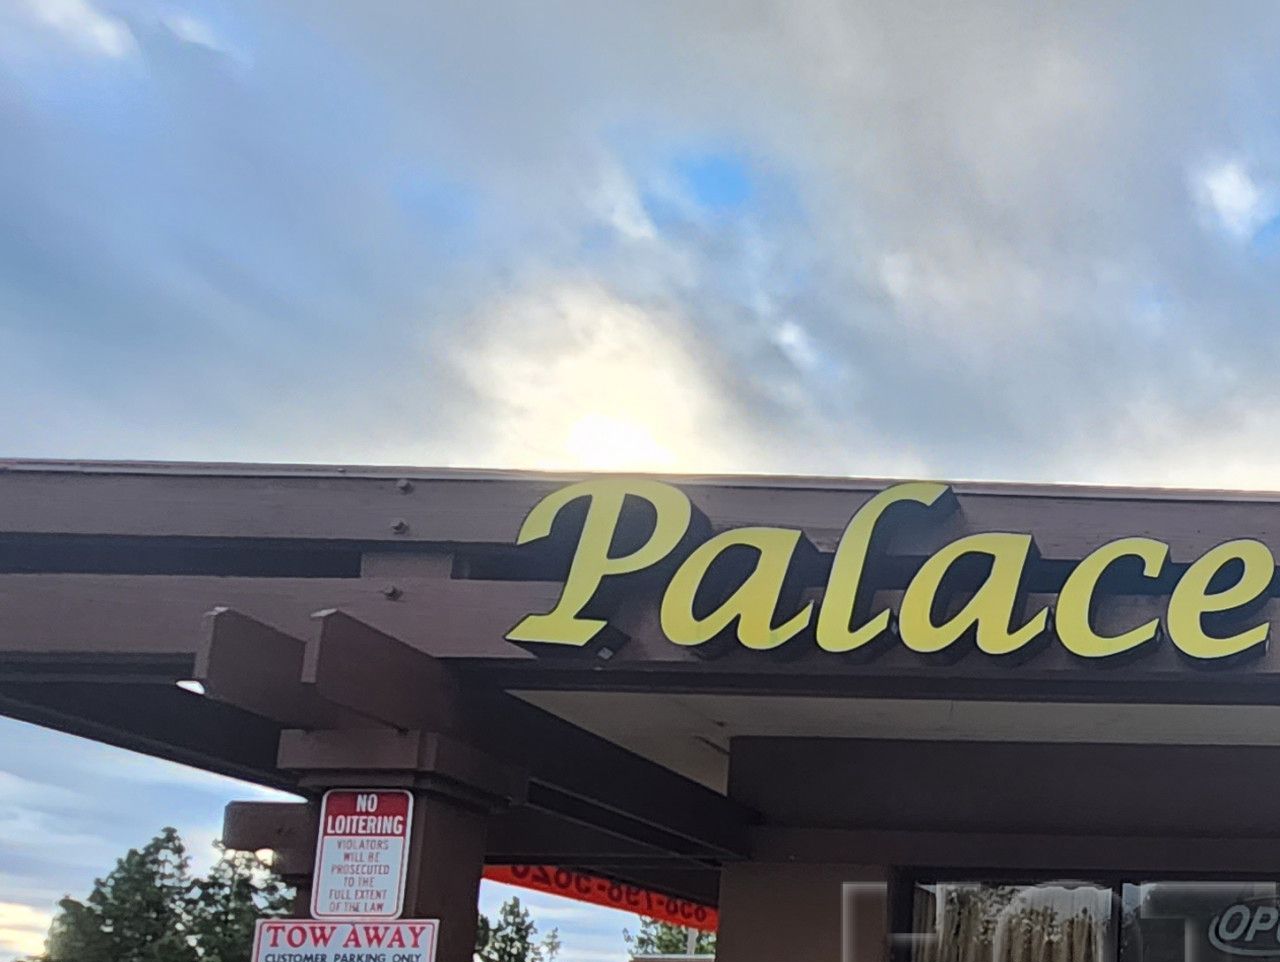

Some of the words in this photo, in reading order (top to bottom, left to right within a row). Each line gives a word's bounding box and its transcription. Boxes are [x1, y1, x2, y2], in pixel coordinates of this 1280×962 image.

[505, 478, 1274, 659] Palace
[356, 794, 378, 812] NO
[326, 814, 404, 834] LOITERING
[337, 840, 389, 850] VIOLATORS
[343, 852, 363, 862] WILL
[368, 853, 380, 862] BE
[331, 864, 390, 875] PROSECUTED
[343, 877, 355, 887] TO
[358, 877, 375, 887] THE
[329, 889, 351, 899] FULL
[354, 889, 387, 900] EXTENT
[364, 903, 385, 913] LAW
[266, 925, 337, 949] TOW
[342, 925, 426, 949] AWAY
